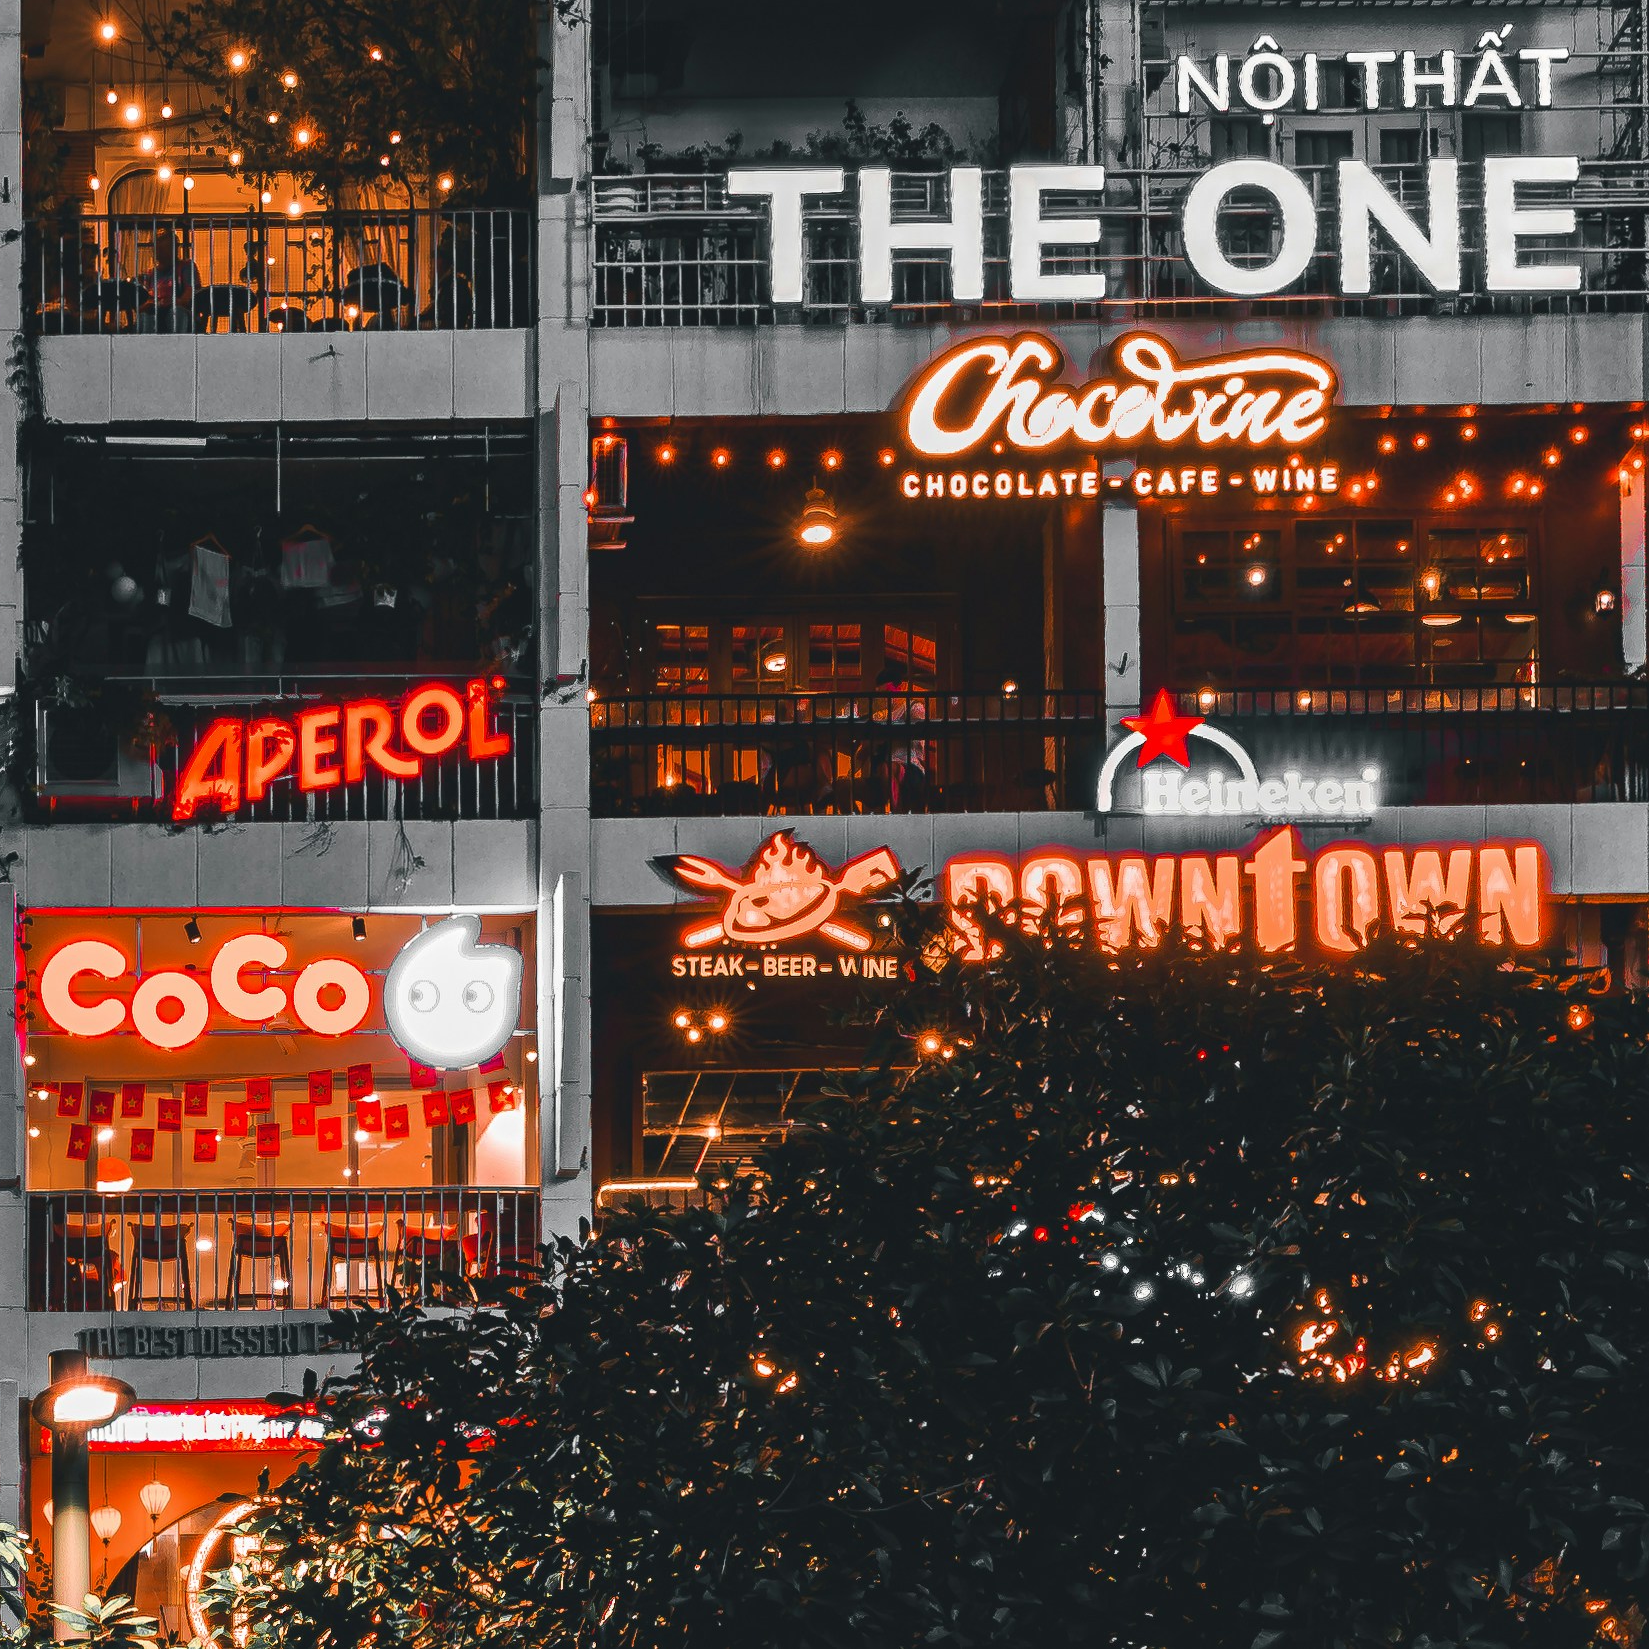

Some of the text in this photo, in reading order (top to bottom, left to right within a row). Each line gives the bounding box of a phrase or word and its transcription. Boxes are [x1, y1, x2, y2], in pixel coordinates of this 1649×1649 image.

[1175, 21, 1570, 127] NỘI THẤT
[727, 154, 1583, 306] THE ONE
[903, 465, 1340, 498] CHOCOLATE CAFE WINE
[169, 678, 511, 824] APEROL
[1142, 768, 1378, 814] Heineken
[671, 954, 746, 978] STEAK
[763, 954, 817, 978] BEER
